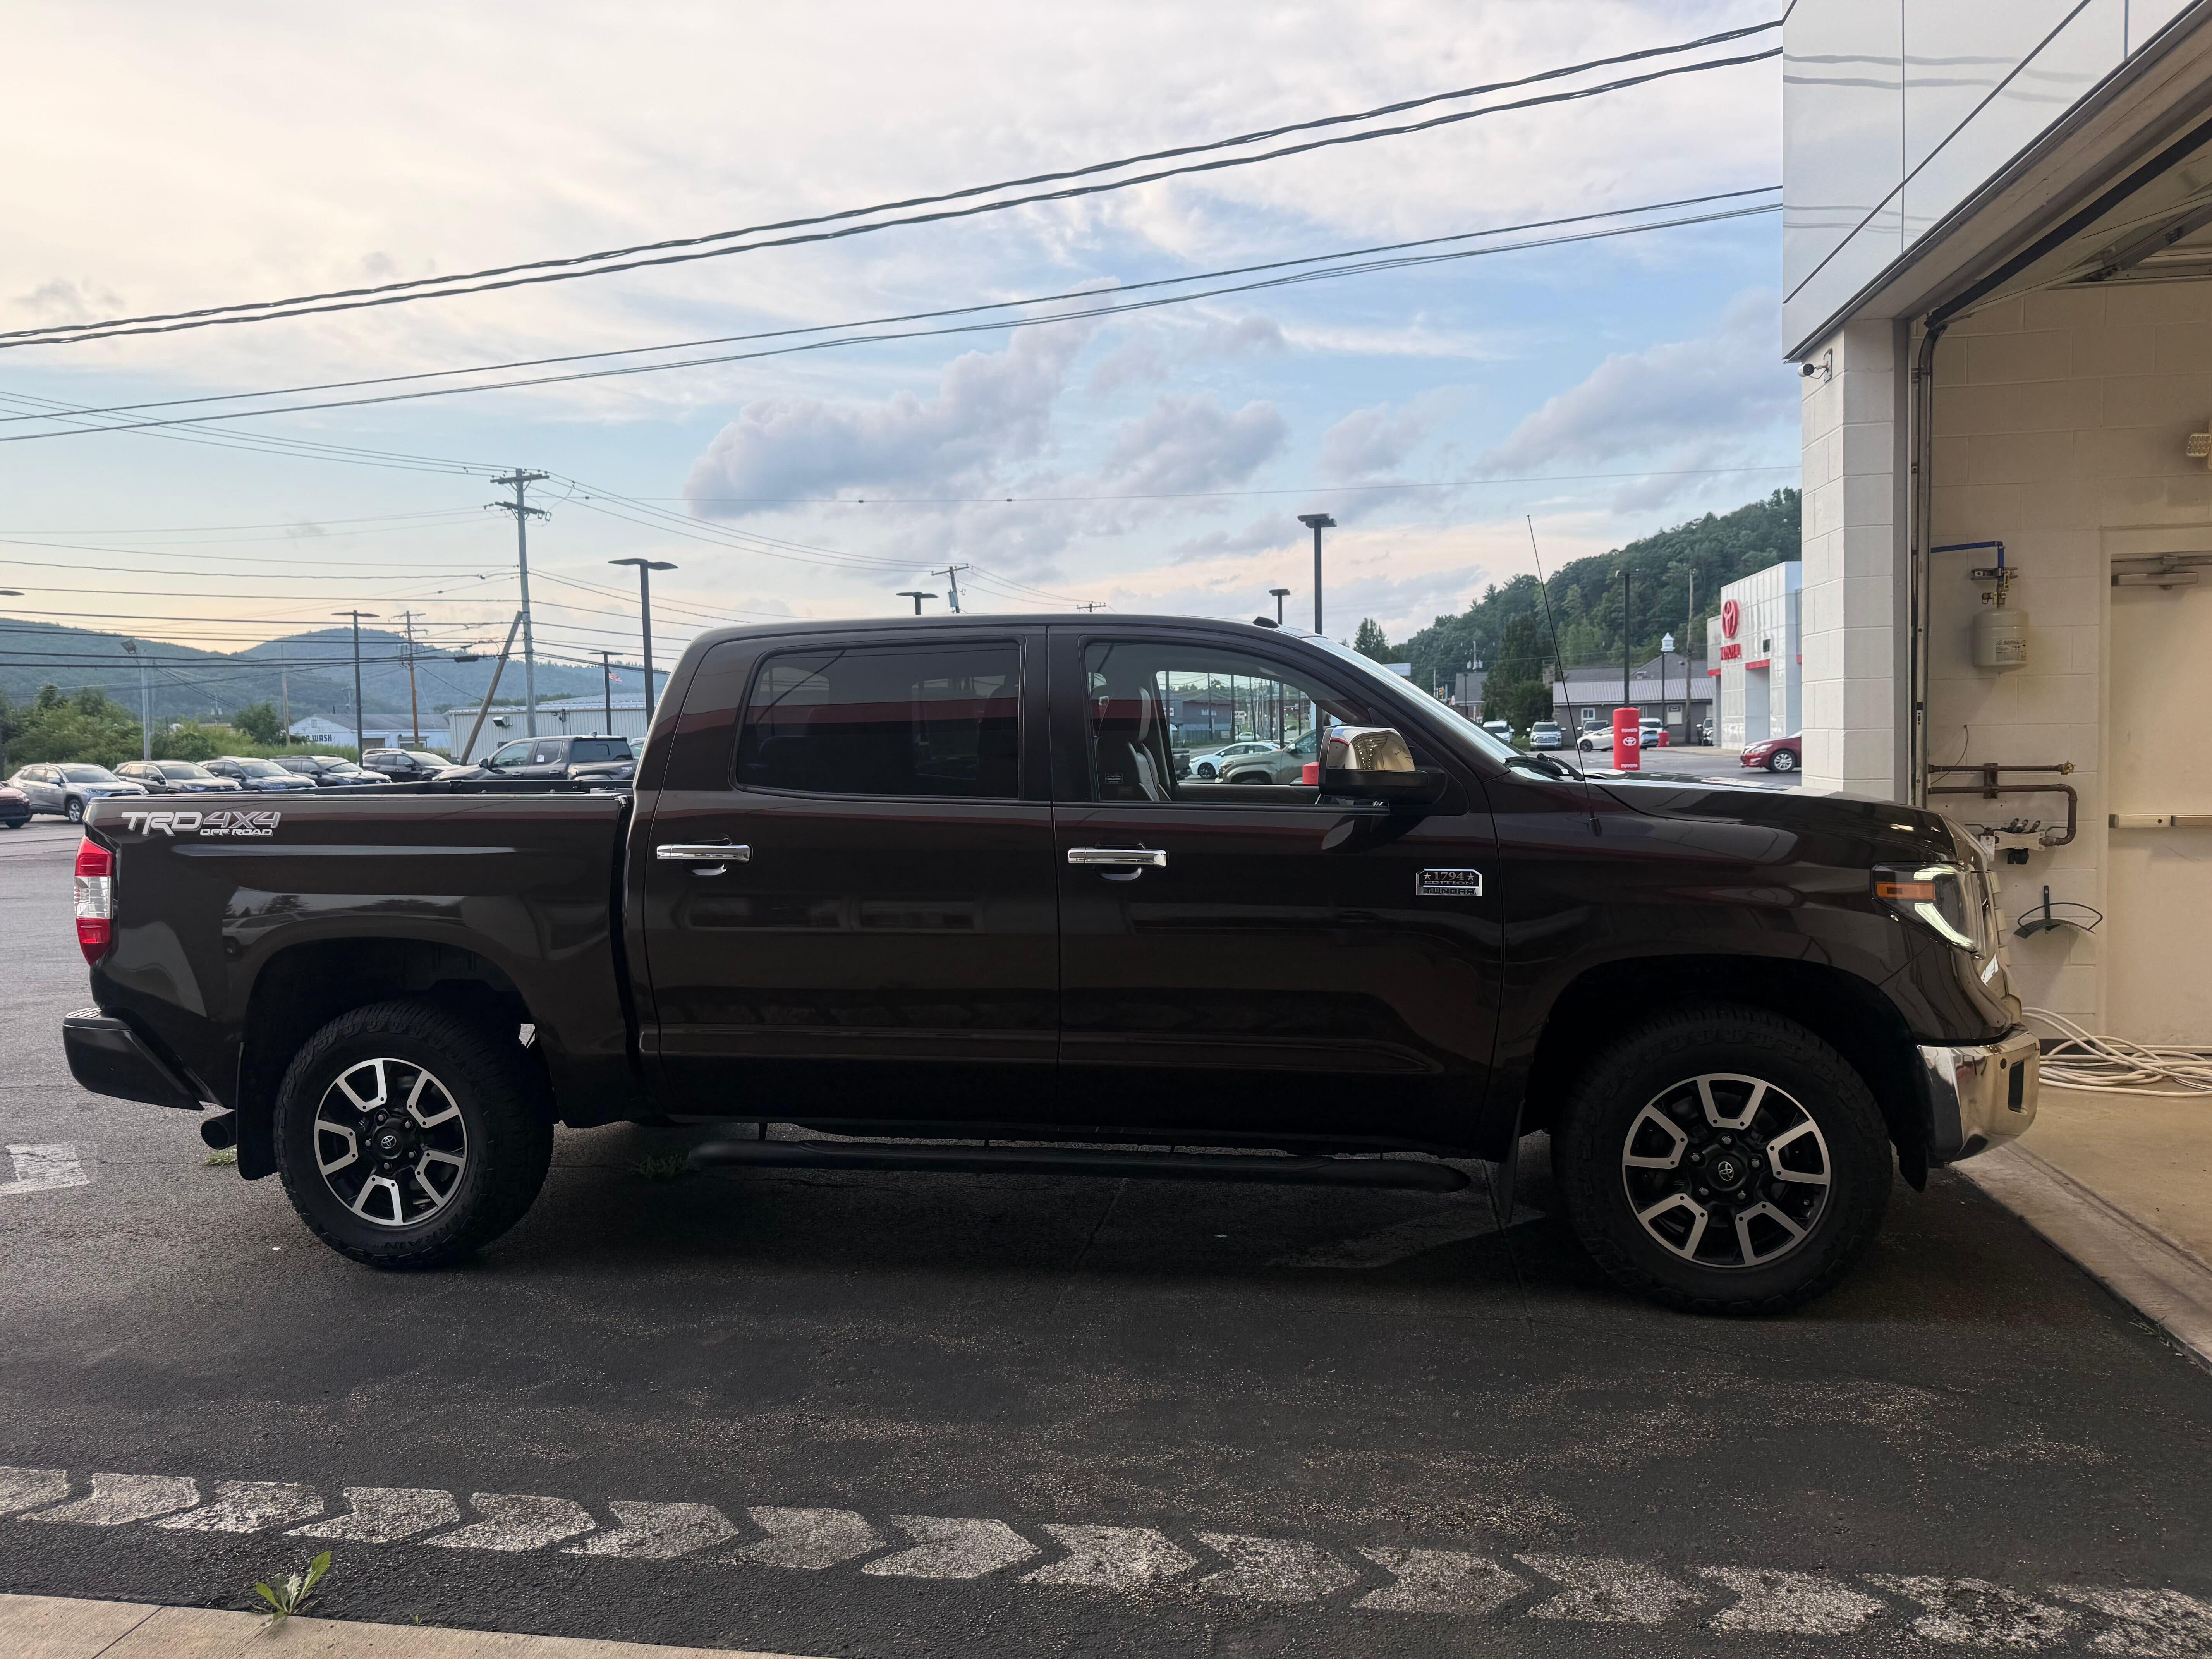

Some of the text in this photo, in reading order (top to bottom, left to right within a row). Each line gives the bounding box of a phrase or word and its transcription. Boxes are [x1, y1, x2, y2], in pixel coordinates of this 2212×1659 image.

[121, 812, 205, 836] TRD
[200, 828, 273, 837] OFF ROAD
[1434, 872, 1464, 880] 1794
